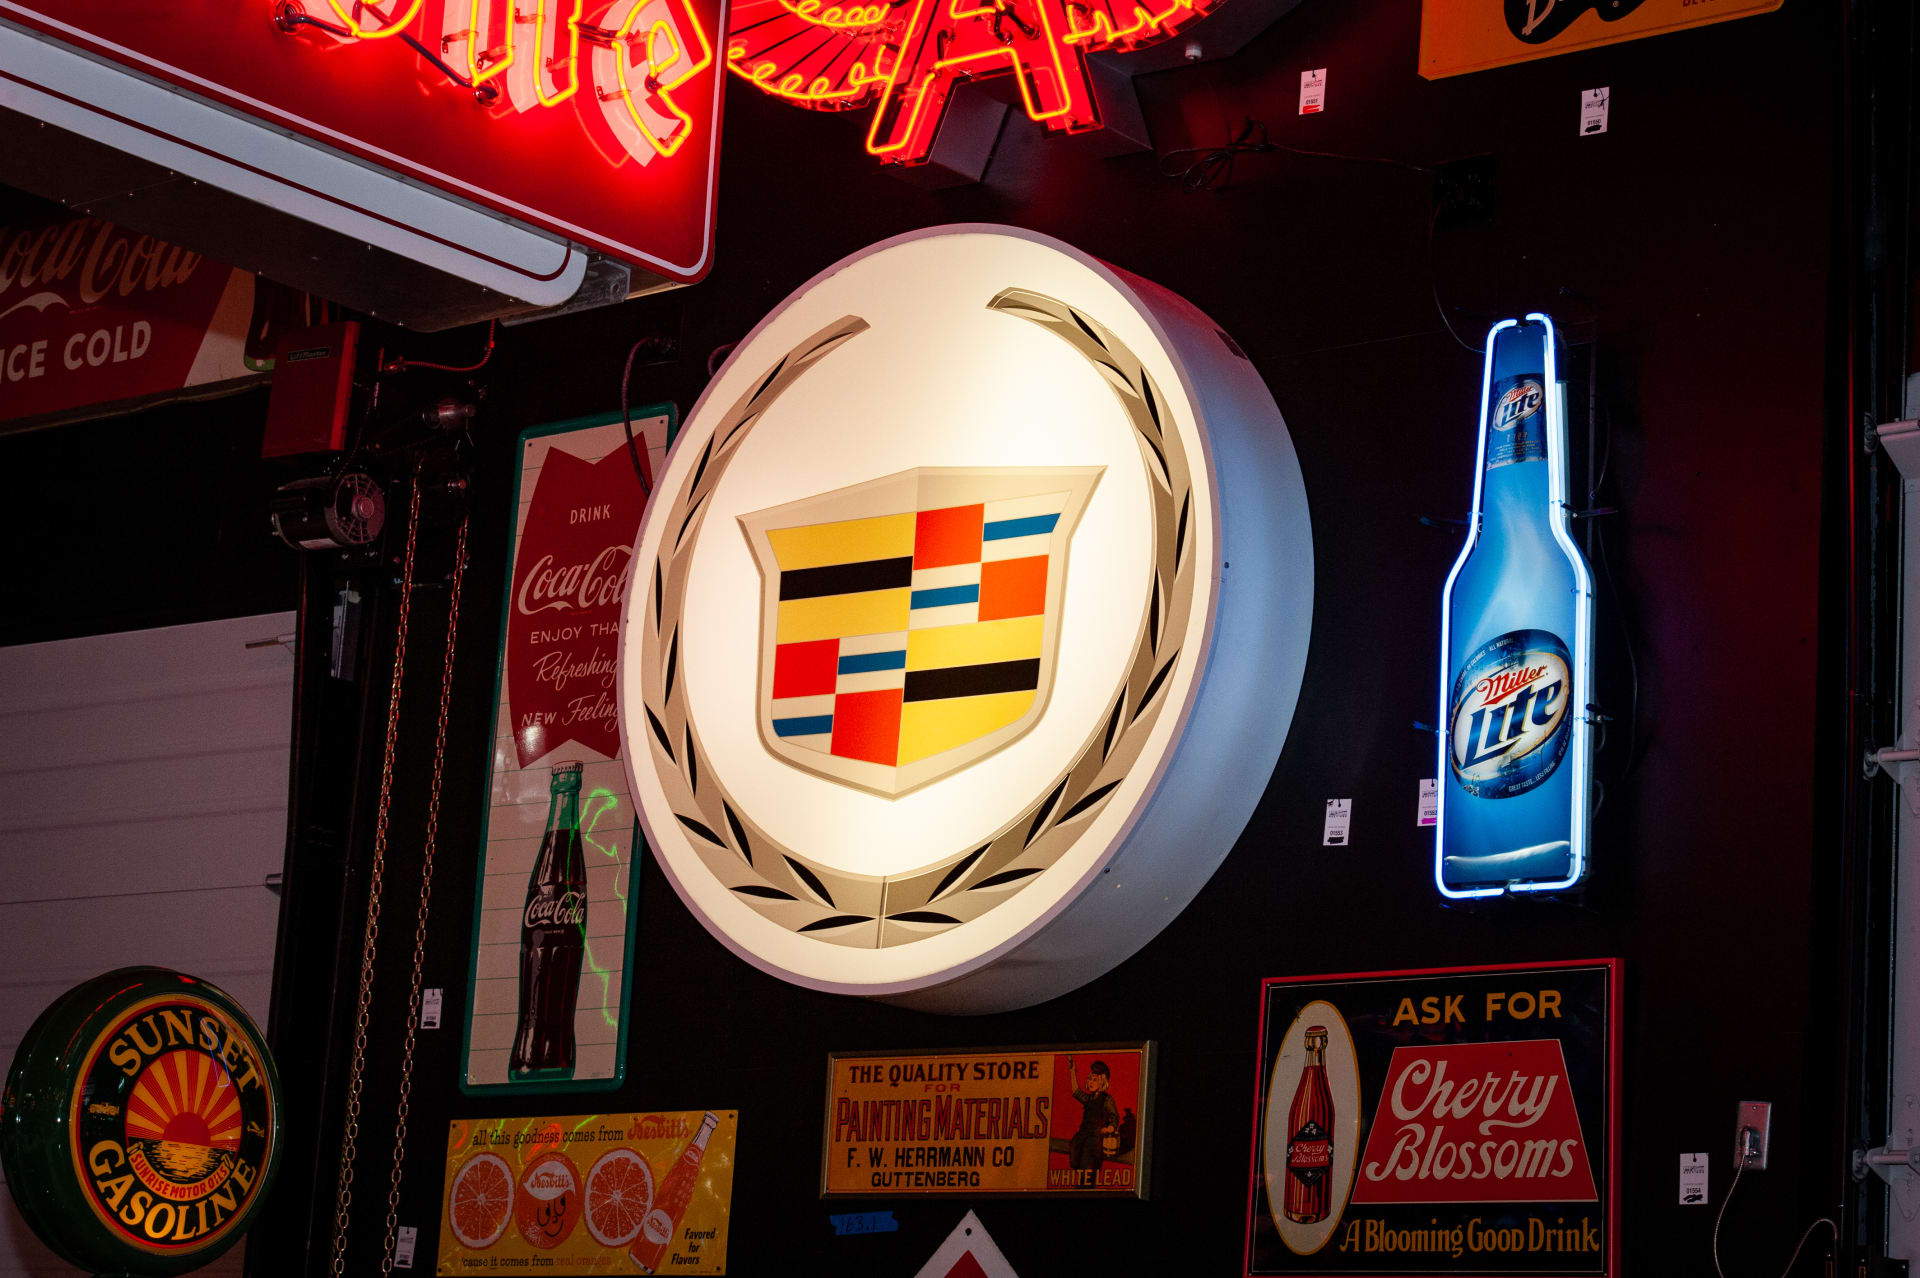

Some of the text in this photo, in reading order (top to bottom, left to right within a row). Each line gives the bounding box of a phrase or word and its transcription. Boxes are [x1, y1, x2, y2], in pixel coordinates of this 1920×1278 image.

[0, 217, 203, 304] oca-Cola
[64, 320, 152, 371] COLD
[1502, 392, 1539, 428] Lite
[570, 504, 611, 524] DRINK
[518, 545, 633, 615] Coca-Col
[530, 622, 619, 644] ENJOY THA
[533, 646, 617, 691] Refreshing
[1476, 664, 1547, 706] Miller
[521, 691, 618, 733] NEW Feeling
[1462, 678, 1562, 770] Lite
[524, 891, 586, 928] Coca-Cola
[1392, 989, 1562, 1027] ASK FOR
[108, 1009, 262, 1093] SUNSET
[849, 1061, 1040, 1086] THE QUALITY STORE
[924, 1084, 961, 1093] FOR
[1391, 1058, 1559, 1136] Cherry
[472, 1129, 487, 1146] all
[490, 1127, 511, 1145] this
[514, 1127, 561, 1149] goodness
[562, 1130, 596, 1144] comes
[597, 1124, 624, 1143] from
[835, 1094, 1049, 1142] PAINTING MATERIALS
[847, 1146, 1015, 1168] F. W. HERRMANN CO
[1295, 1143, 1325, 1154] Cherry
[1365, 1122, 1578, 1182] Blossoms
[89, 1139, 257, 1241] GASOLINE
[131, 1153, 228, 1198] SUNRISE MOTOR OILS
[871, 1171, 980, 1188] GUTTENBERG
[1049, 1168, 1131, 1187] WHITE LEAD
[684, 1227, 716, 1241] Favored
[688, 1242, 700, 1253] for
[1339, 1218, 1360, 1253] A
[1364, 1217, 1464, 1259] Blooming
[1528, 1216, 1600, 1253] Drink
[490, 1256, 498, 1267] it
[500, 1257, 529, 1267] comes
[531, 1254, 554, 1267] from
[671, 1253, 700, 1266] Flavors
